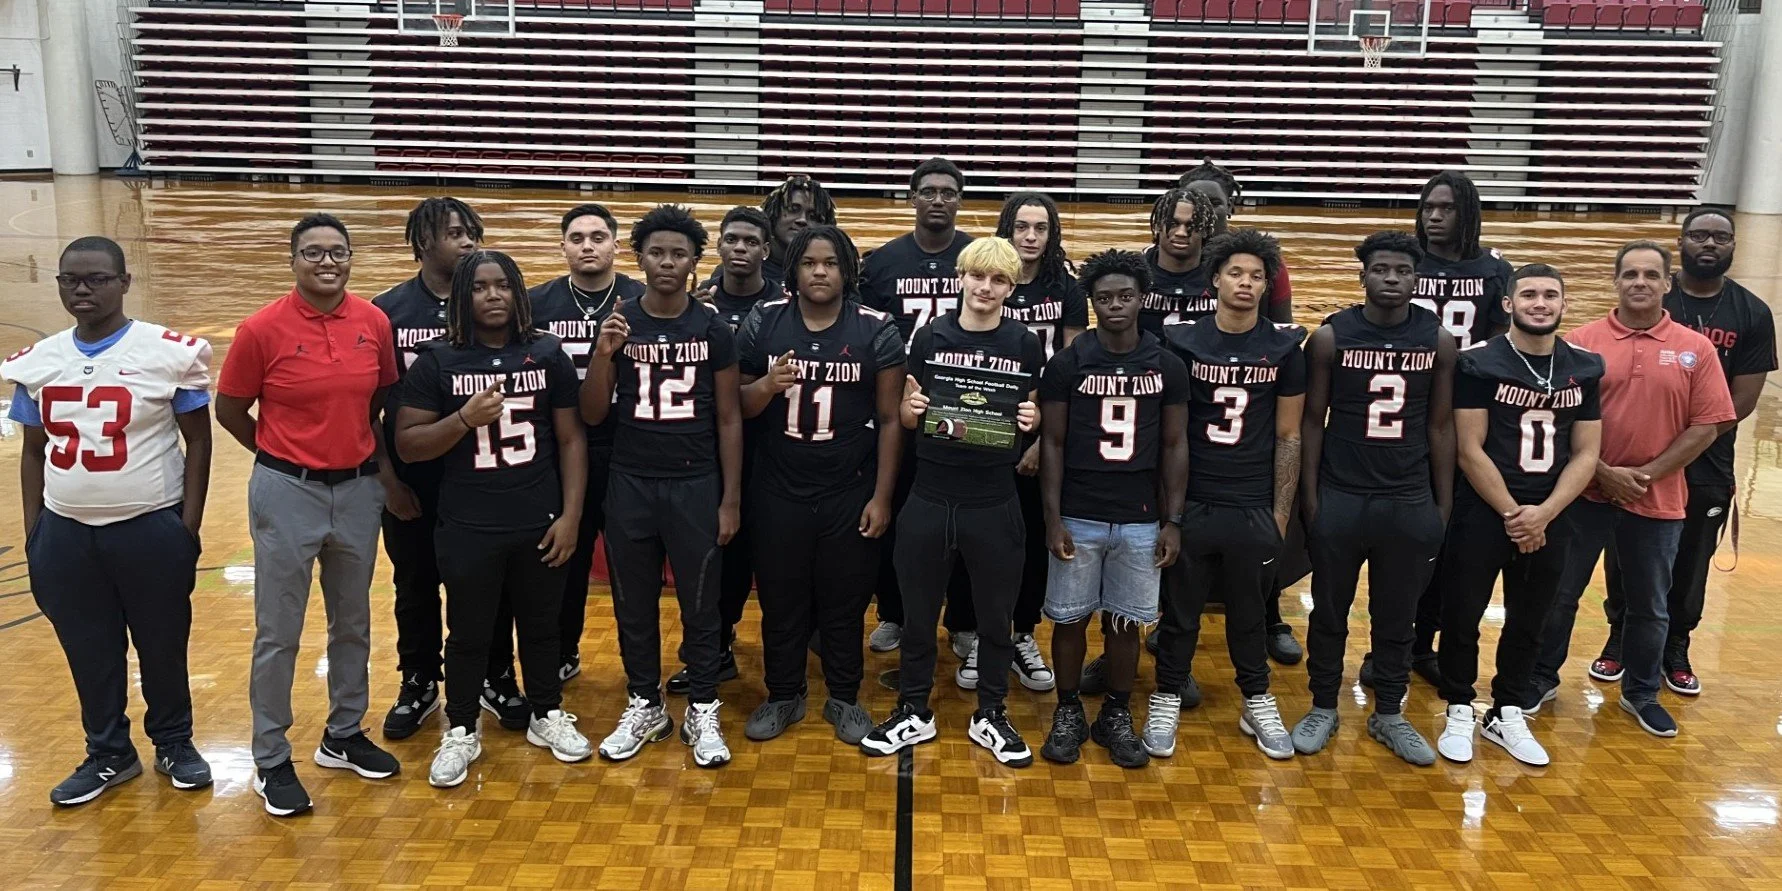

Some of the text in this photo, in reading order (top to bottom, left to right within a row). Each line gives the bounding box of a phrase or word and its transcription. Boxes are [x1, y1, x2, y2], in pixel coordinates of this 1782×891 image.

[896, 277, 963, 295] MOUNT ZIO
[1410, 278, 1484, 297] UNT ZION
[1001, 301, 1062, 321] UNT ZION
[1142, 292, 1218, 312] OUNT ZION
[548, 320, 596, 339] MOUNT
[1409, 298, 1476, 350] 8
[623, 341, 709, 364] MOUNT ZION
[989, 356, 1021, 373] ZION
[1342, 350, 1436, 371] MOUNT ZION
[768, 354, 861, 382] MNT ZION
[1192, 360, 1278, 385] MOUNT ZION
[452, 368, 546, 396] MOUNT ZION
[633, 363, 697, 420] 12
[1005, 383, 1019, 391] Daily
[1078, 373, 1164, 396] MOUNT ZION
[1495, 382, 1583, 408] MOUNT ZION
[784, 383, 836, 441] 11
[1206, 386, 1250, 446] 3
[1365, 373, 1408, 440] 2
[40, 386, 133, 472] 53
[475, 396, 537, 469] 15
[1099, 396, 1137, 462] 9
[1518, 409, 1556, 473] 0
